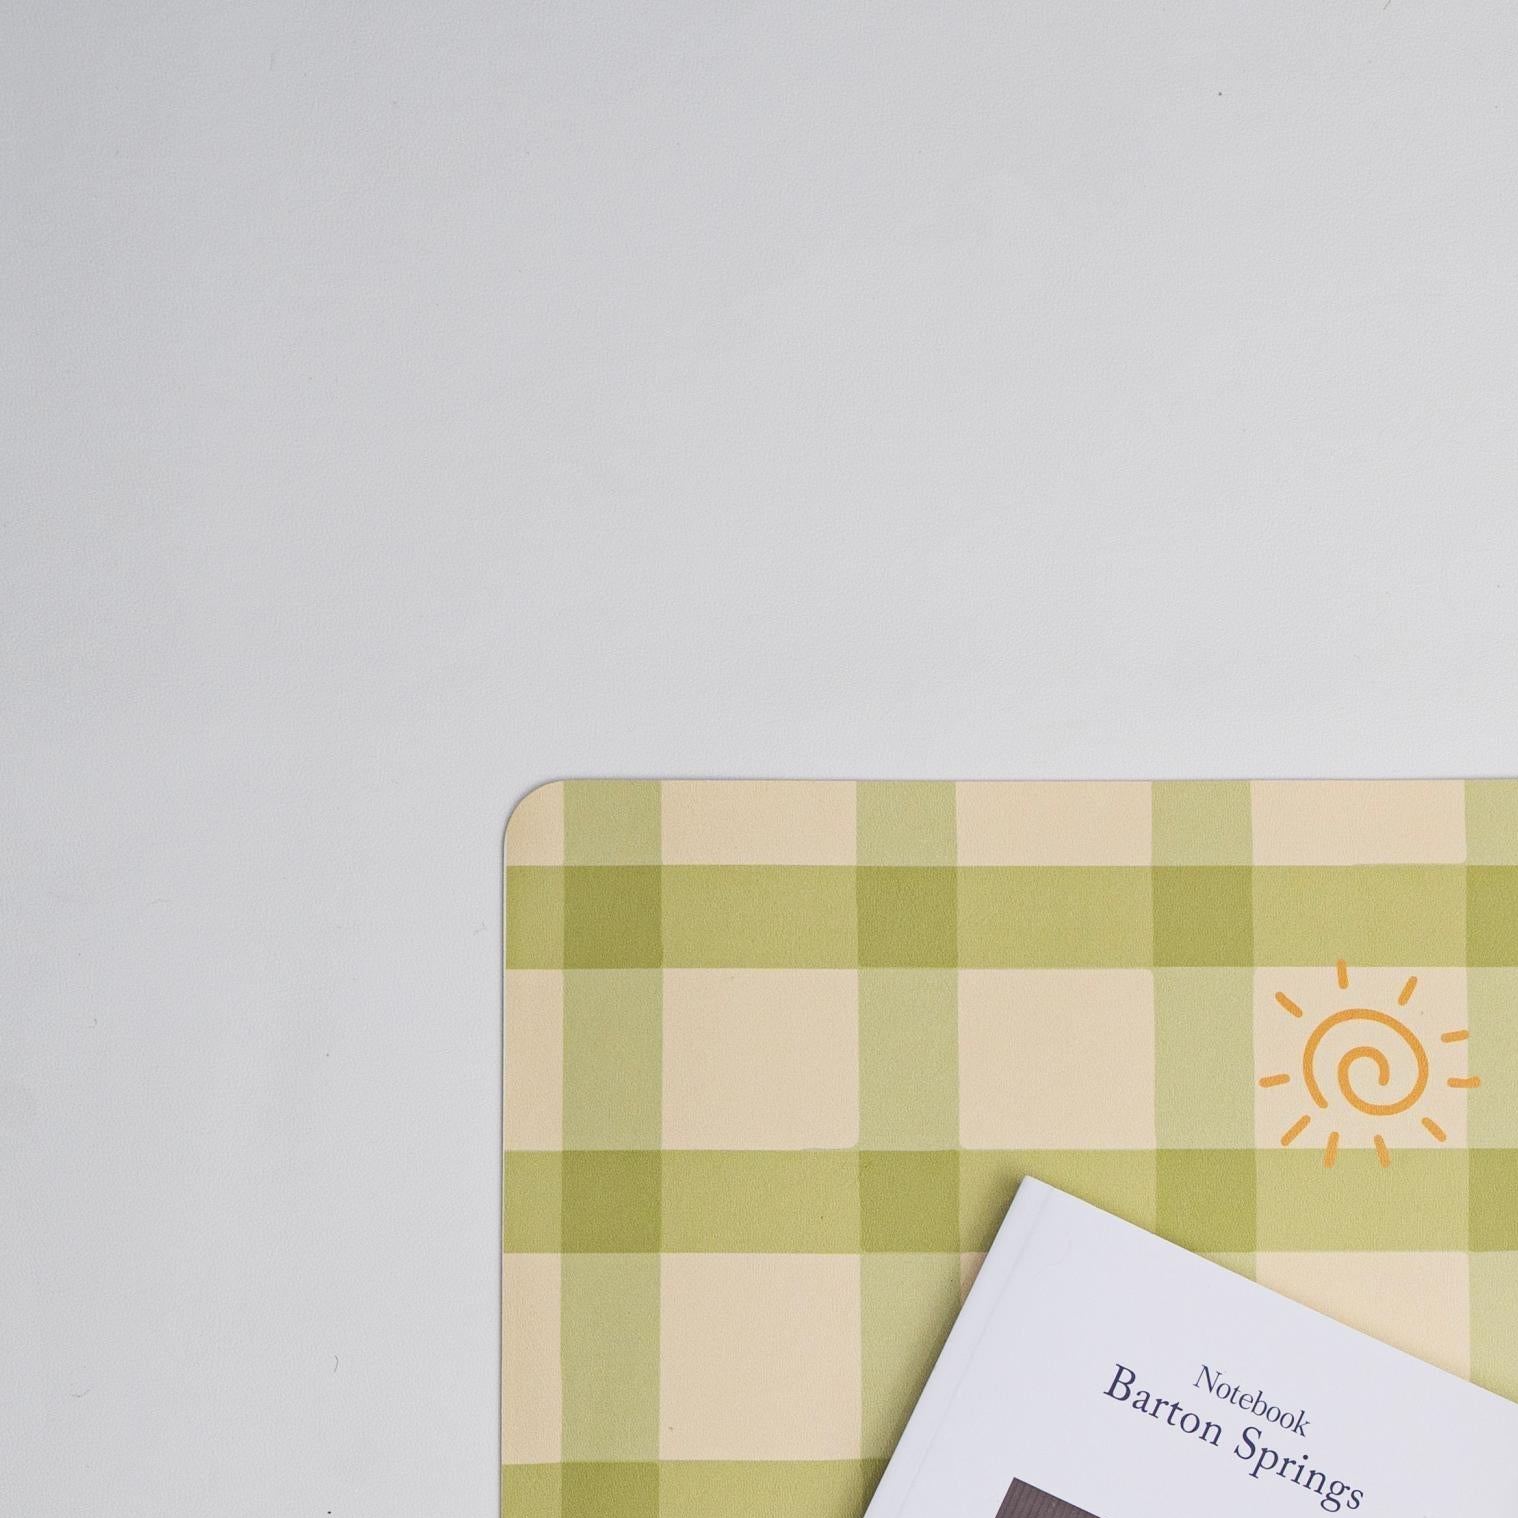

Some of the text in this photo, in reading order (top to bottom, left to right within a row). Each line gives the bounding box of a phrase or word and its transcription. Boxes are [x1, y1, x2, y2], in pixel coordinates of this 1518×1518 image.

[1103, 1363, 1365, 1513] Barton Springs
[1192, 1363, 1312, 1438] Notebook
